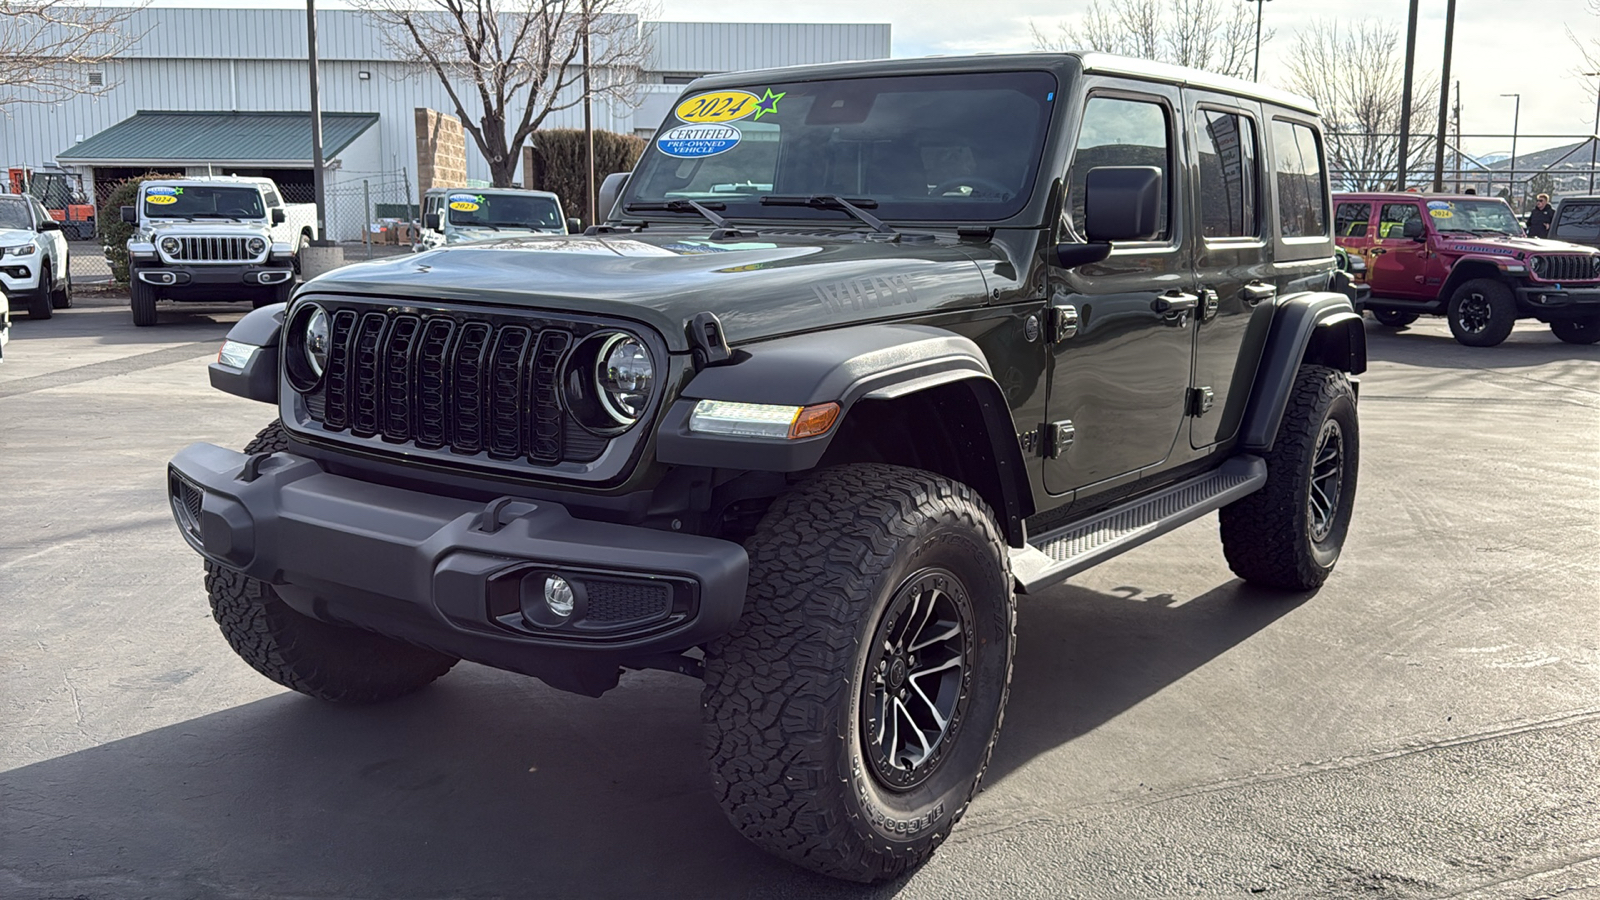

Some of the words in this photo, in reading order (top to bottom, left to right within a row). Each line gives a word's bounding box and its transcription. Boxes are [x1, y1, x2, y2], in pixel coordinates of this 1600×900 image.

[684, 96, 751, 118] 2024
[669, 128, 734, 140] CERTIFIED
[1454, 244, 1513, 255] RUBICON
